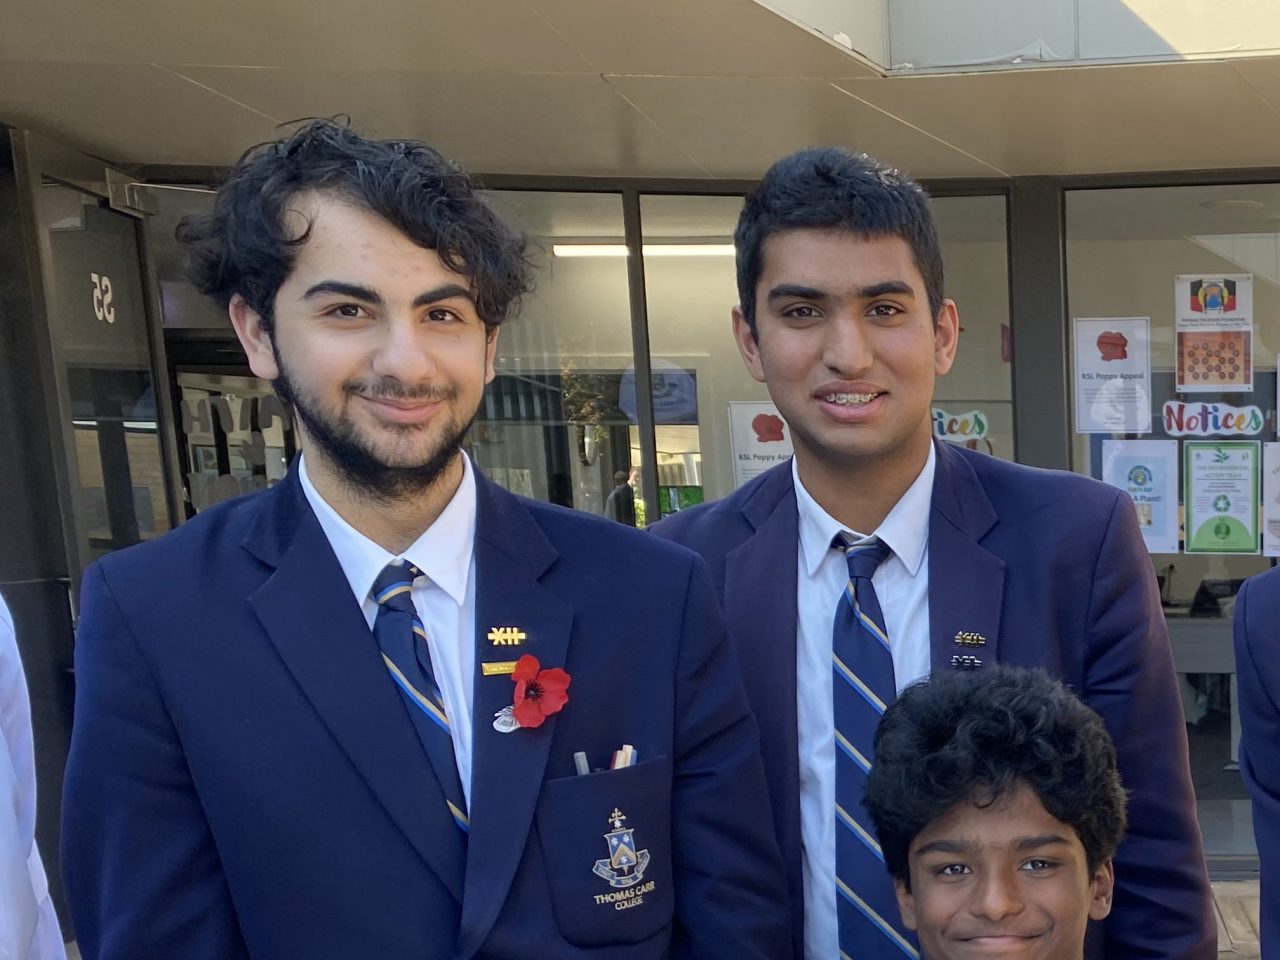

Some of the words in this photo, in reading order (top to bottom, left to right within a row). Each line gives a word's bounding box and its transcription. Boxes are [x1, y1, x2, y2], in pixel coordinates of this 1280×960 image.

[1120, 372, 1145, 381] Appeal
[1166, 404, 1261, 432] Notices
[753, 454, 775, 462] Poppy
[593, 888, 635, 904] THOMAS
[635, 881, 655, 896] CARR
[615, 895, 643, 910] COLLEGE
